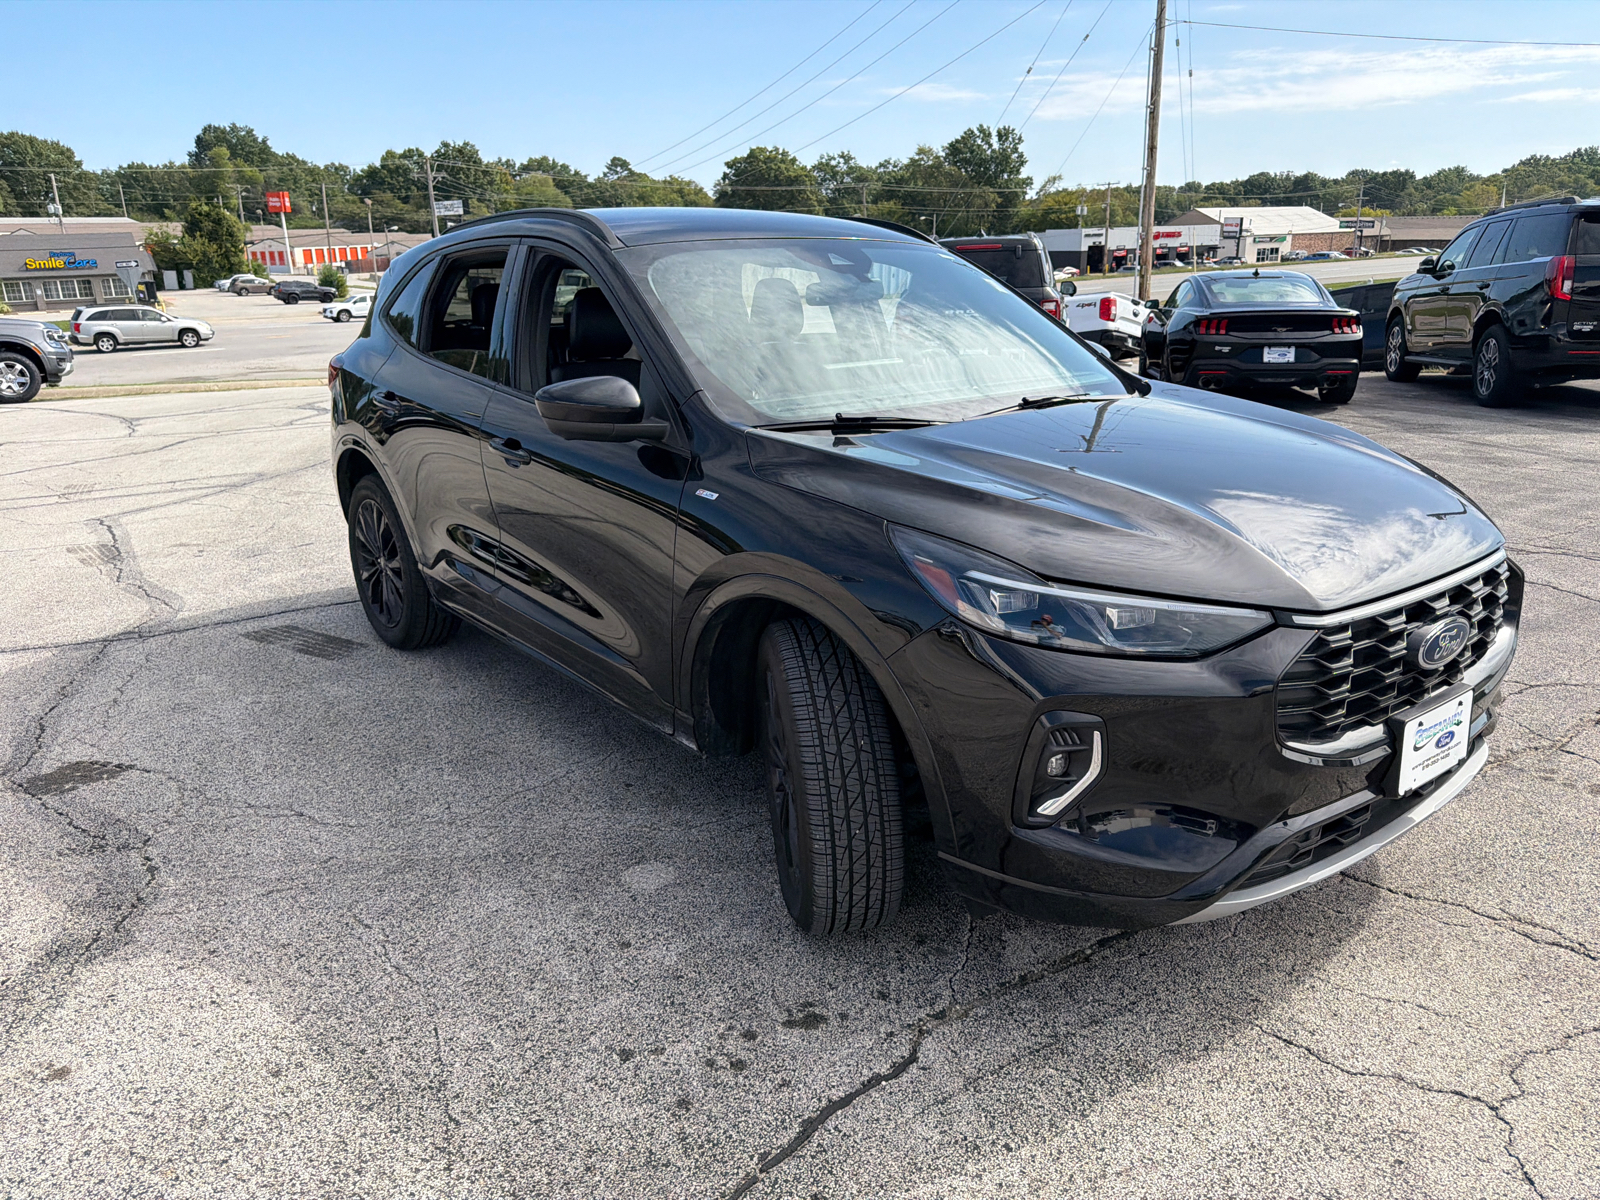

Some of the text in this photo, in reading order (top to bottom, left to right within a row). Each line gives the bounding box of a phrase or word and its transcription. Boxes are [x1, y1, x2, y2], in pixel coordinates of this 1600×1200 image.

[25, 256, 98, 269] Smile Care
[1434, 628, 1464, 660] Ford
